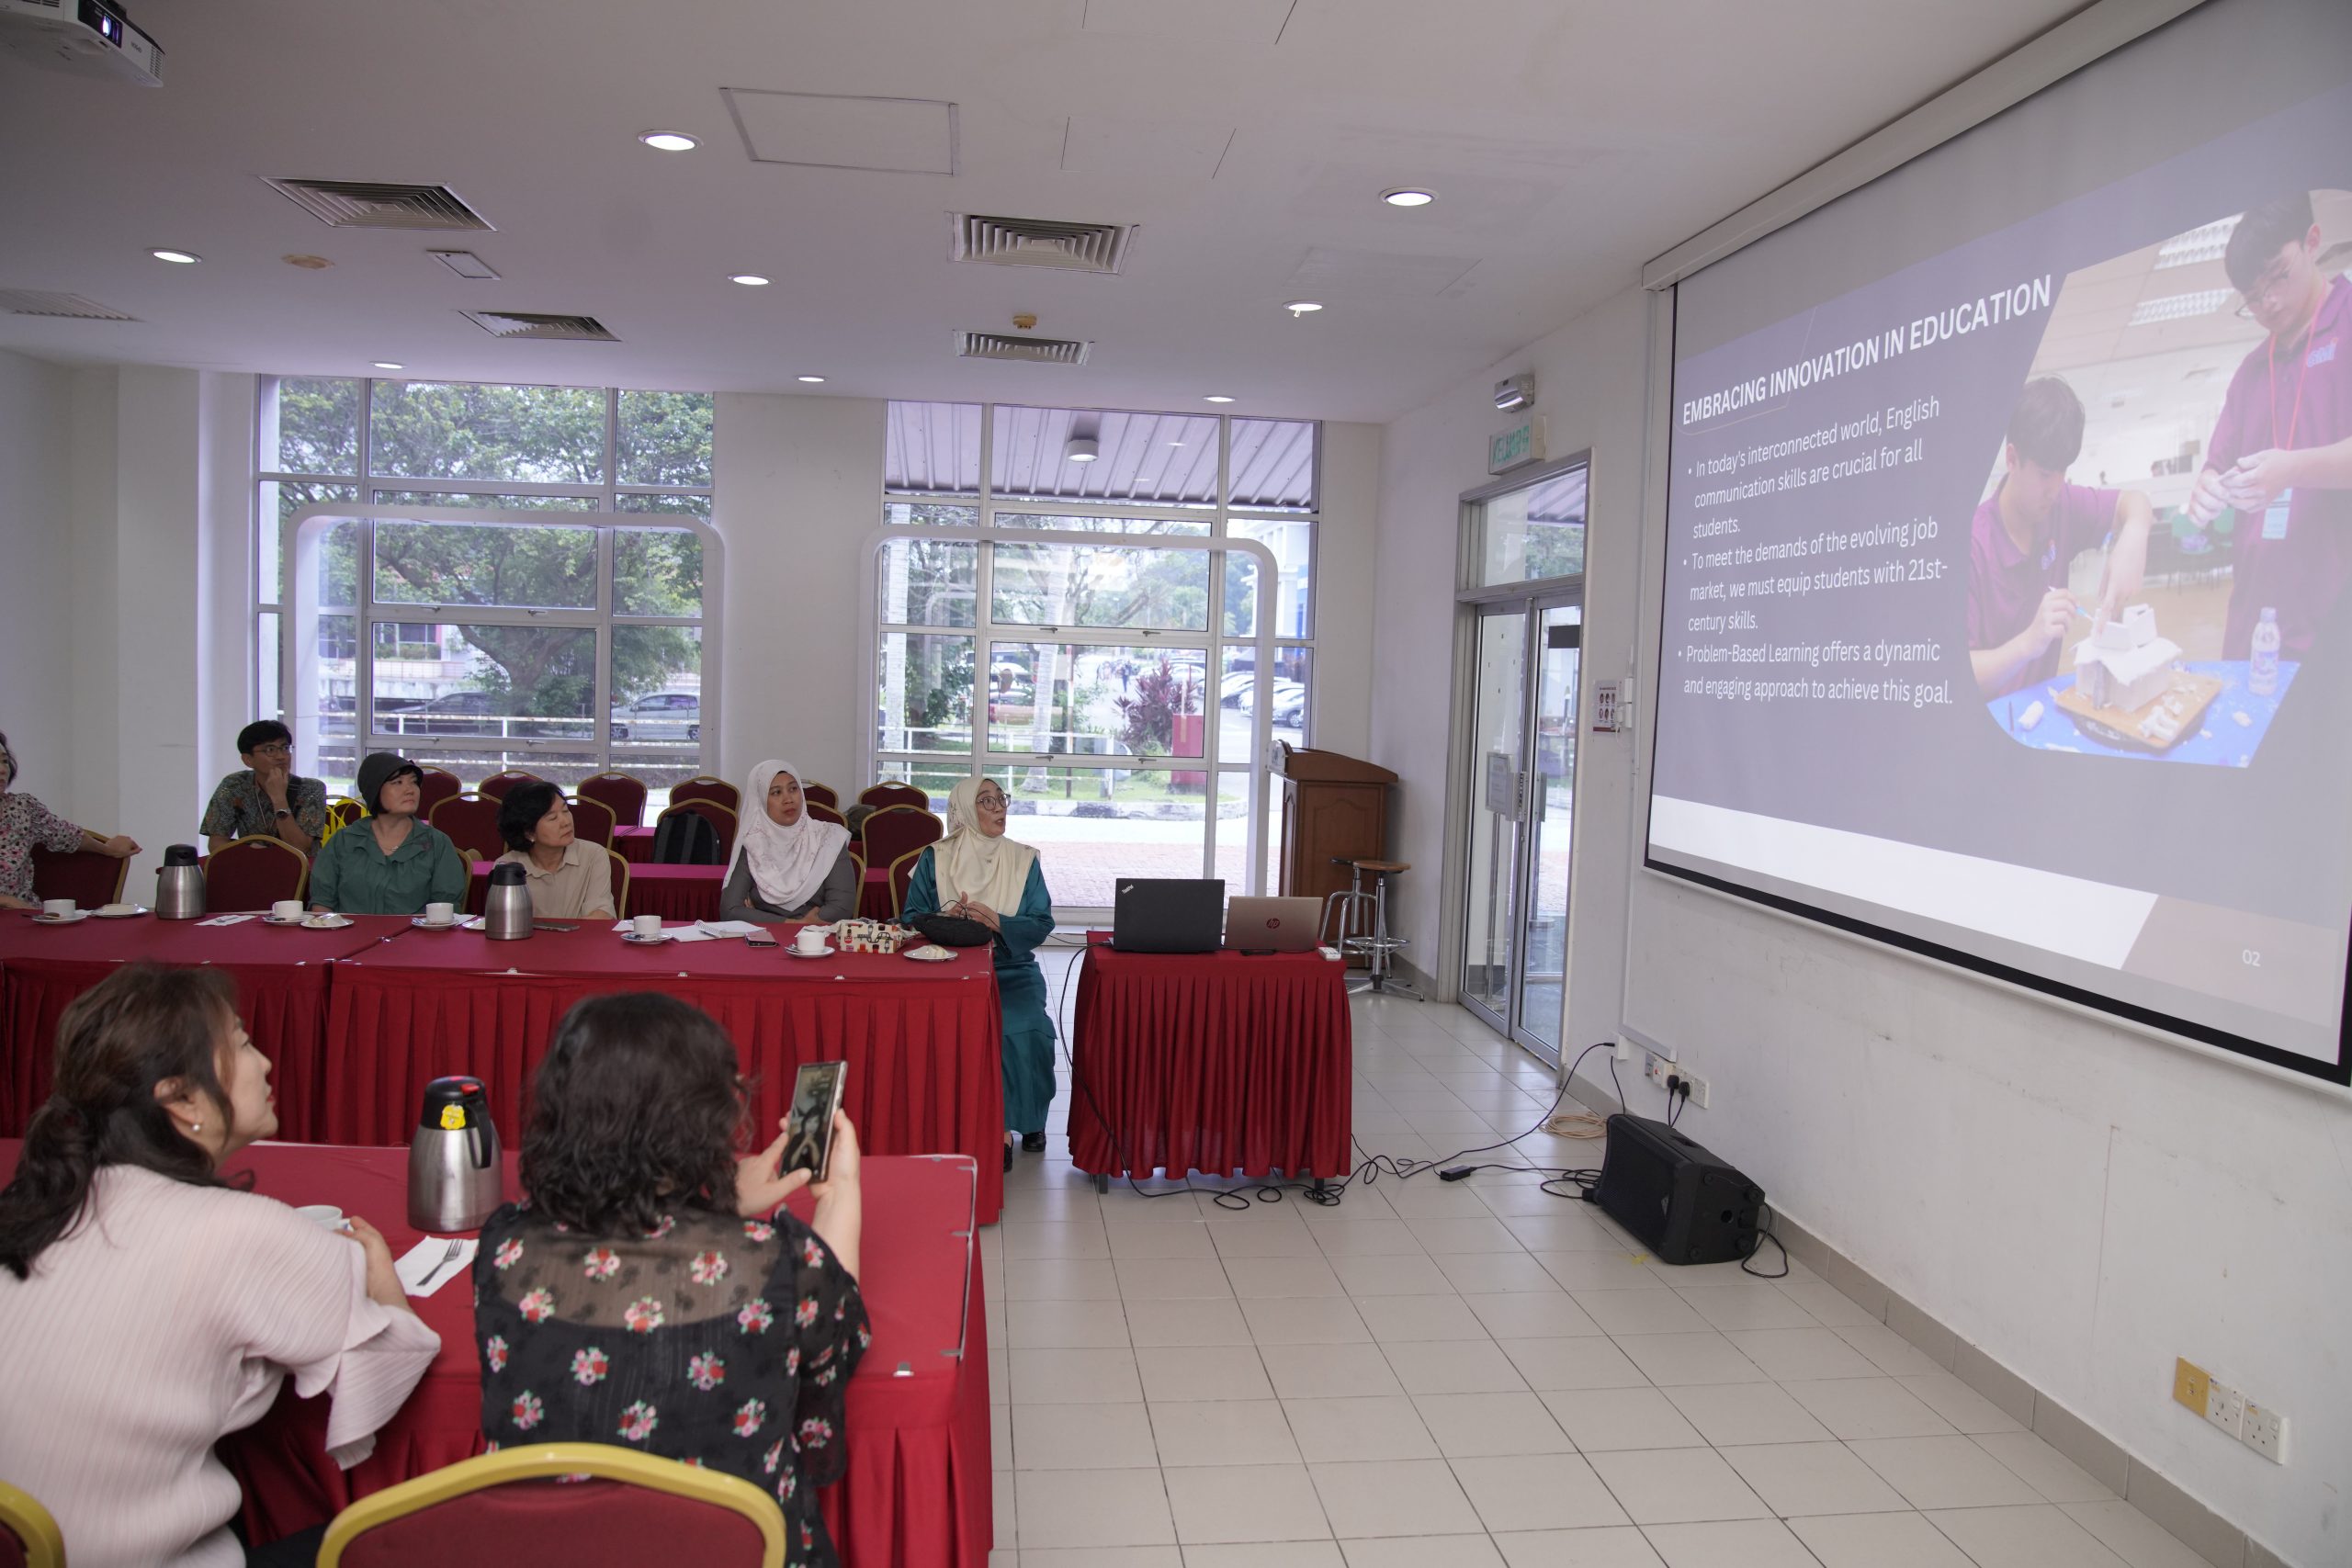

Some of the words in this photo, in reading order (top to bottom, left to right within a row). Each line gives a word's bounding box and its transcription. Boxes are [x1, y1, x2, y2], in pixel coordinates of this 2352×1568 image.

[1683, 377, 1766, 425] EMBRACING
[1770, 335, 1880, 397] INNOVATION
[1883, 326, 1905, 359] IN
[1909, 274, 2051, 351] EDUCATION
[1696, 460, 1705, 478] In
[1708, 450, 1746, 474] today's
[1747, 422, 1838, 465] interconnected
[1841, 411, 1882, 436] world,
[1886, 395, 1939, 430] English
[1694, 477, 1775, 508] communication
[1778, 467, 1806, 491] skills
[1809, 464, 1829, 484] are
[1832, 448, 1876, 479] crucial
[1880, 446, 1902, 468] for
[1905, 438, 1922, 463] all
[1692, 517, 1741, 539] students.
[1692, 552, 1703, 570] To
[1706, 548, 1732, 568] meet
[1735, 546, 1752, 565] the
[1755, 536, 1807, 562] demands
[1810, 532, 1825, 555] of
[1826, 530, 1847, 552] the
[1849, 521, 1909, 548] evolving
[1911, 515, 1938, 547] job
[1690, 581, 1726, 602] market,
[1729, 581, 1746, 598] we
[1747, 576, 1775, 596] must
[1777, 570, 1811, 598] equip
[1814, 566, 1870, 591] students
[1873, 558, 1905, 584] with
[1907, 558, 1948, 581] 21st-
[1688, 614, 1726, 635] century
[1727, 610, 1758, 629] skills.
[1686, 643, 1767, 662] Problem-Based
[1769, 641, 1819, 668] Learning
[1822, 640, 1860, 662] offers
[1862, 645, 1871, 661] a
[1874, 637, 1940, 667] dynamic
[1684, 676, 1704, 694] and
[1705, 676, 1752, 701] engaging
[1754, 677, 1808, 703] approach
[1812, 679, 1826, 699] to
[1827, 677, 1880, 701] achieve
[1882, 678, 1911, 702] this
[1913, 679, 1953, 708] goal.
[2242, 949, 2261, 967] 02
